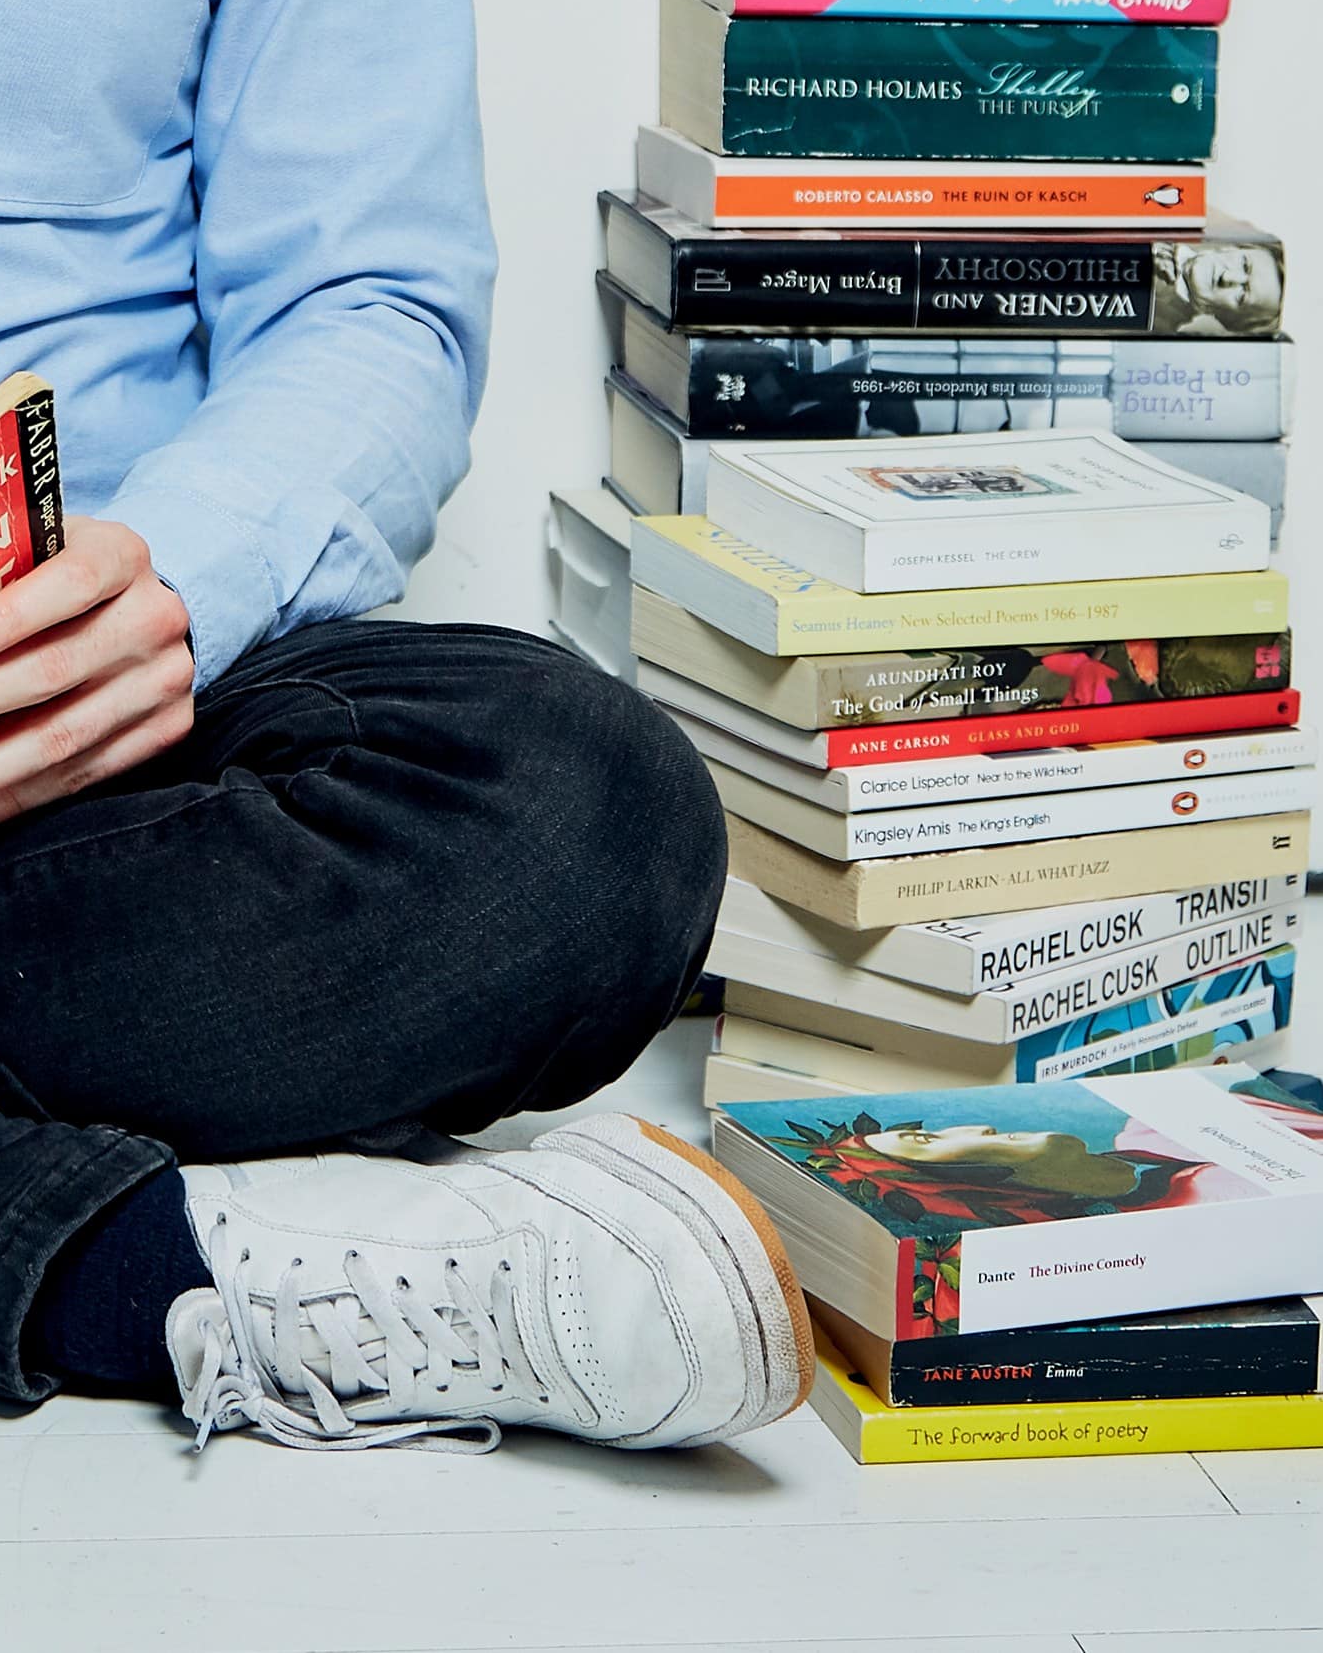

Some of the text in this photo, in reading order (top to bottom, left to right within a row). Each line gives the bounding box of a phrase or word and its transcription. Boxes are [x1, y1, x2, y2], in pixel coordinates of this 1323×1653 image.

[748, 62, 1102, 119] RICHARD HOLMES Shelley
[794, 189, 1088, 204] ROBERTO CALASSO THE RUIN OF KASCH
[760, 269, 902, 295] Bryan Magee
[934, 257, 1141, 283] PHILOSOPHY
[933, 292, 1138, 317] WAGNER AND
[1127, 363, 1252, 394] on Paper
[1122, 396, 1215, 422] Living
[26, 398, 57, 495] FABER
[38, 494, 57, 532] paper
[892, 549, 1041, 568] JOSEPH KESSEL THE CREW
[866, 662, 1007, 688] ARUNDHATI ROY
[832, 684, 1040, 717] The God of Small Things
[850, 722, 1080, 755] ANNE CARSON GLASS AND GOD
[854, 813, 1052, 846] Kingsley Amis The King's English
[898, 860, 1110, 899] PHILIP LARKIN ALL WHAT JAZZ
[1012, 913, 1274, 1034] RACHEL CUSK OUTLINE
[977, 1253, 1147, 1285] Dante The Divine Comedy
[923, 1363, 1085, 1382] JANE AUSTEN Emma
[907, 1421, 1149, 1446] The forward book of poetry
